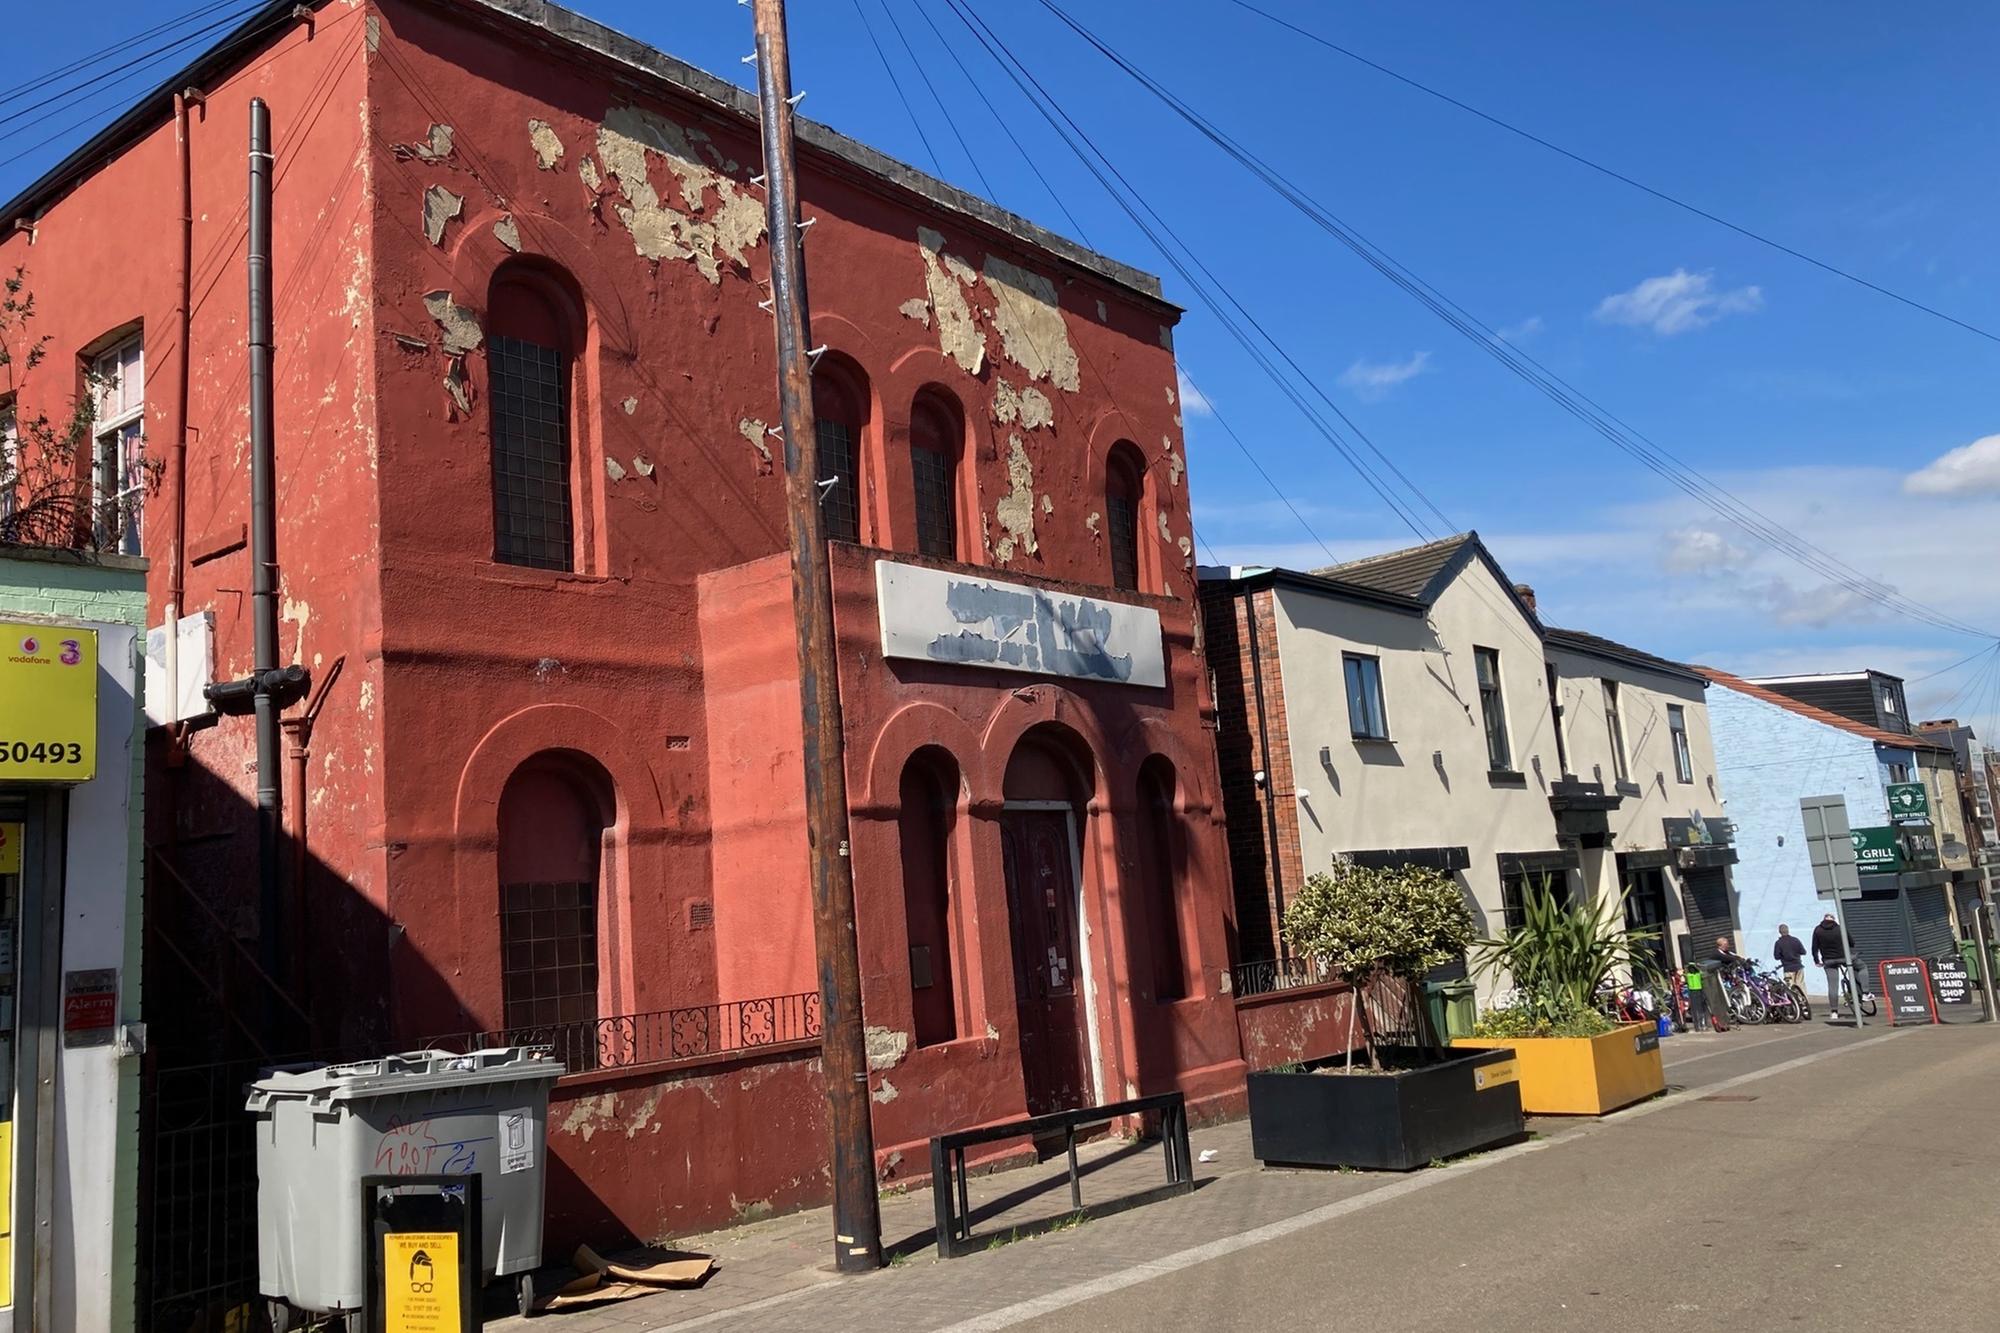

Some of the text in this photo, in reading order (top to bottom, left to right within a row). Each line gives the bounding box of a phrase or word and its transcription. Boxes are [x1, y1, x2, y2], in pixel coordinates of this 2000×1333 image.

[59, 639, 82, 666] 3
[8, 655, 51, 665] vodafone
[0, 741, 82, 764] 50493
[1862, 848, 1895, 858] GRILL
[1932, 971, 1967, 980] SECOND
[1940, 989, 1965, 997] SHOP
[67, 999, 114, 1010] Alarm
